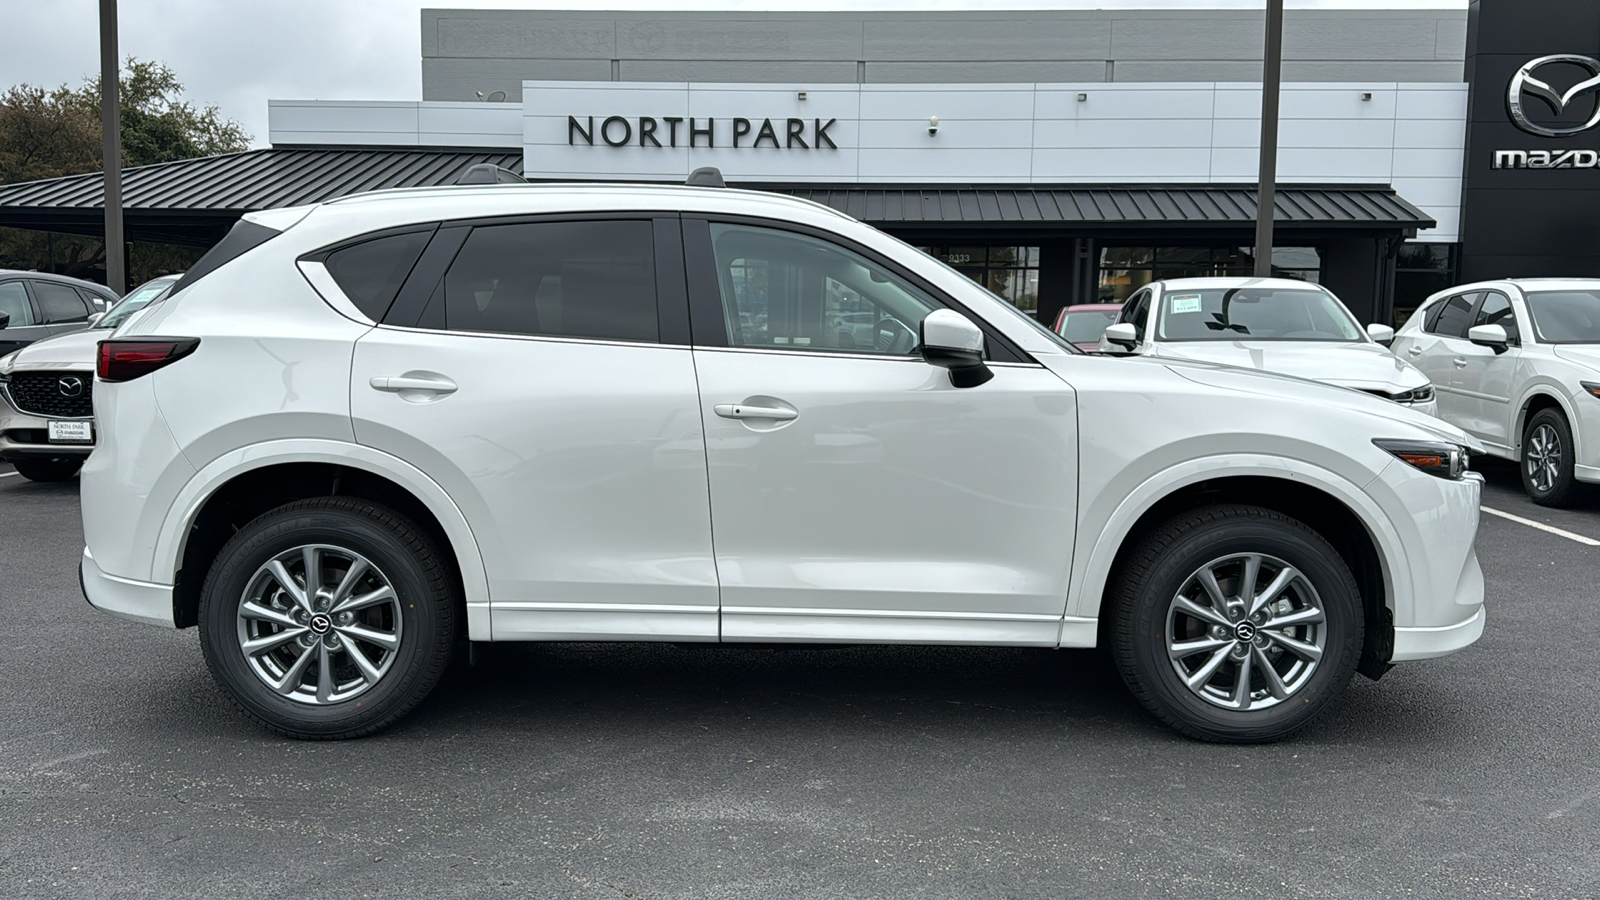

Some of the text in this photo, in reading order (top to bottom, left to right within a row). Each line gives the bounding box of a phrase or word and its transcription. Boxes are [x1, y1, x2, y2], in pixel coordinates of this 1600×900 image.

[568, 115, 838, 149] NORTH PARK
[1490, 149, 1600, 169] mazd
[948, 253, 970, 262] 9333
